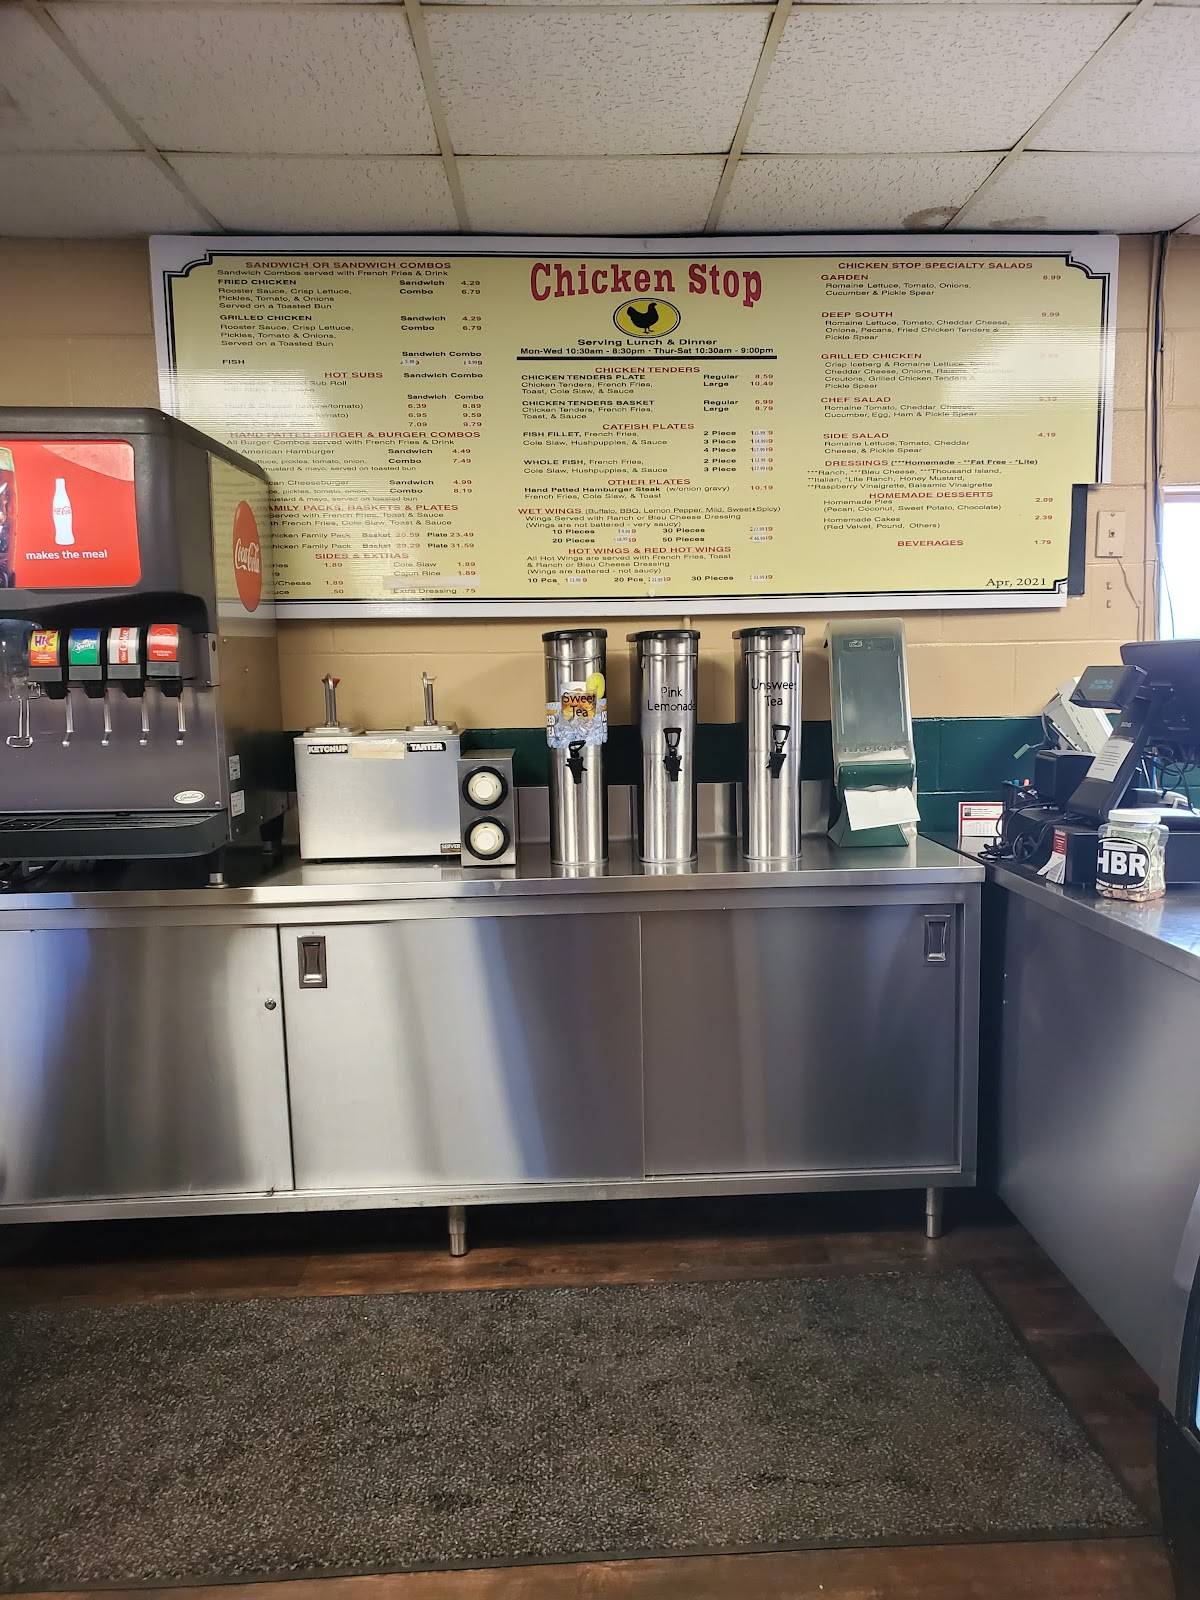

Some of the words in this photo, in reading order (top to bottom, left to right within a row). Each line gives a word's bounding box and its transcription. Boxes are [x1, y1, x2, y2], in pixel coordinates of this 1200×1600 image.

[531, 263, 675, 300] Chicken
[688, 264, 761, 308] Stop
[26, 550, 60, 560] makes
[62, 550, 80, 559] the
[83, 549, 107, 559] meal
[986, 578, 1012, 587] Apr,
[563, 692, 596, 704] Sweet
[661, 686, 682, 698] Pink
[764, 695, 783, 706] Tea
[570, 706, 588, 718] Tea
[410, 743, 442, 751] TARTER
[1097, 849, 1146, 878] HBR
